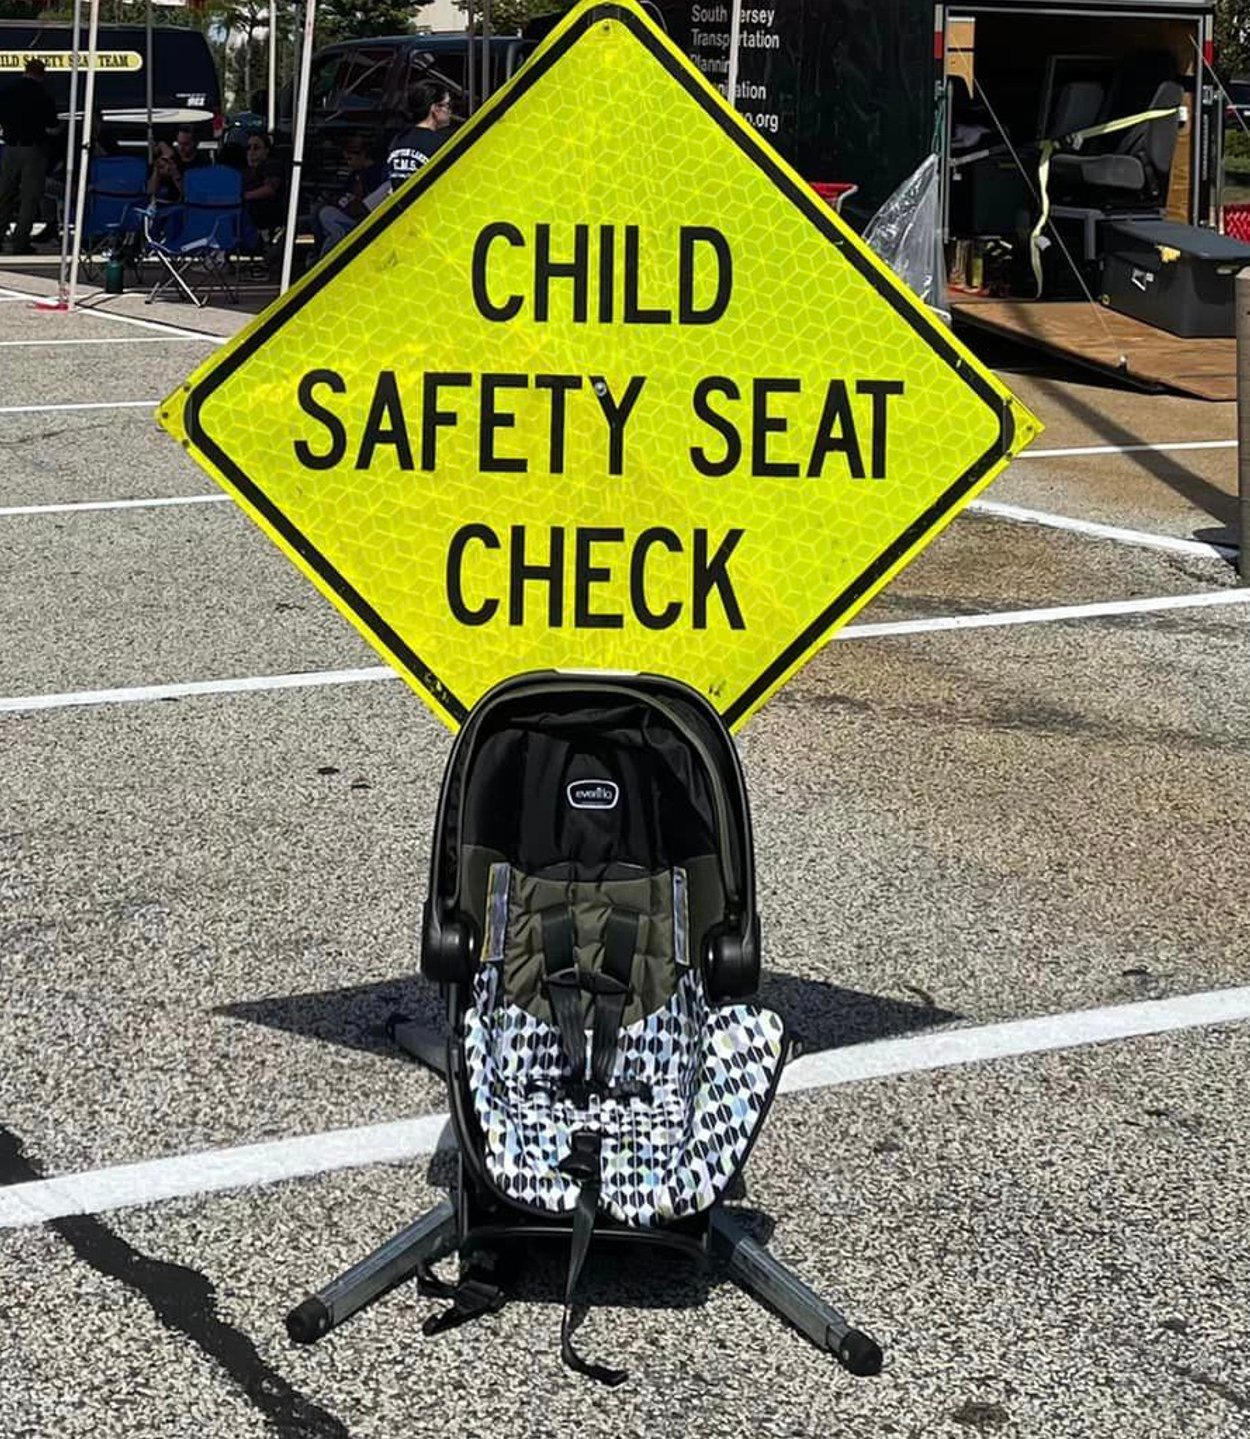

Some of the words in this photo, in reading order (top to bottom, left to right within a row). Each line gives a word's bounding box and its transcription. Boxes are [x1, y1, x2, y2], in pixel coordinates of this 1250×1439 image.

[691, 4, 728, 23] South
[740, 8, 775, 28] ersey
[691, 28, 780, 50] Transprtation
[98, 54, 129, 68] TEAM
[691, 53, 731, 73] Plannin
[744, 113, 779, 132] o.org
[472, 222, 732, 325] CHILD
[294, 369, 646, 475] SAFETY
[690, 376, 904, 479] SEAT
[446, 523, 746, 630] CHECK
